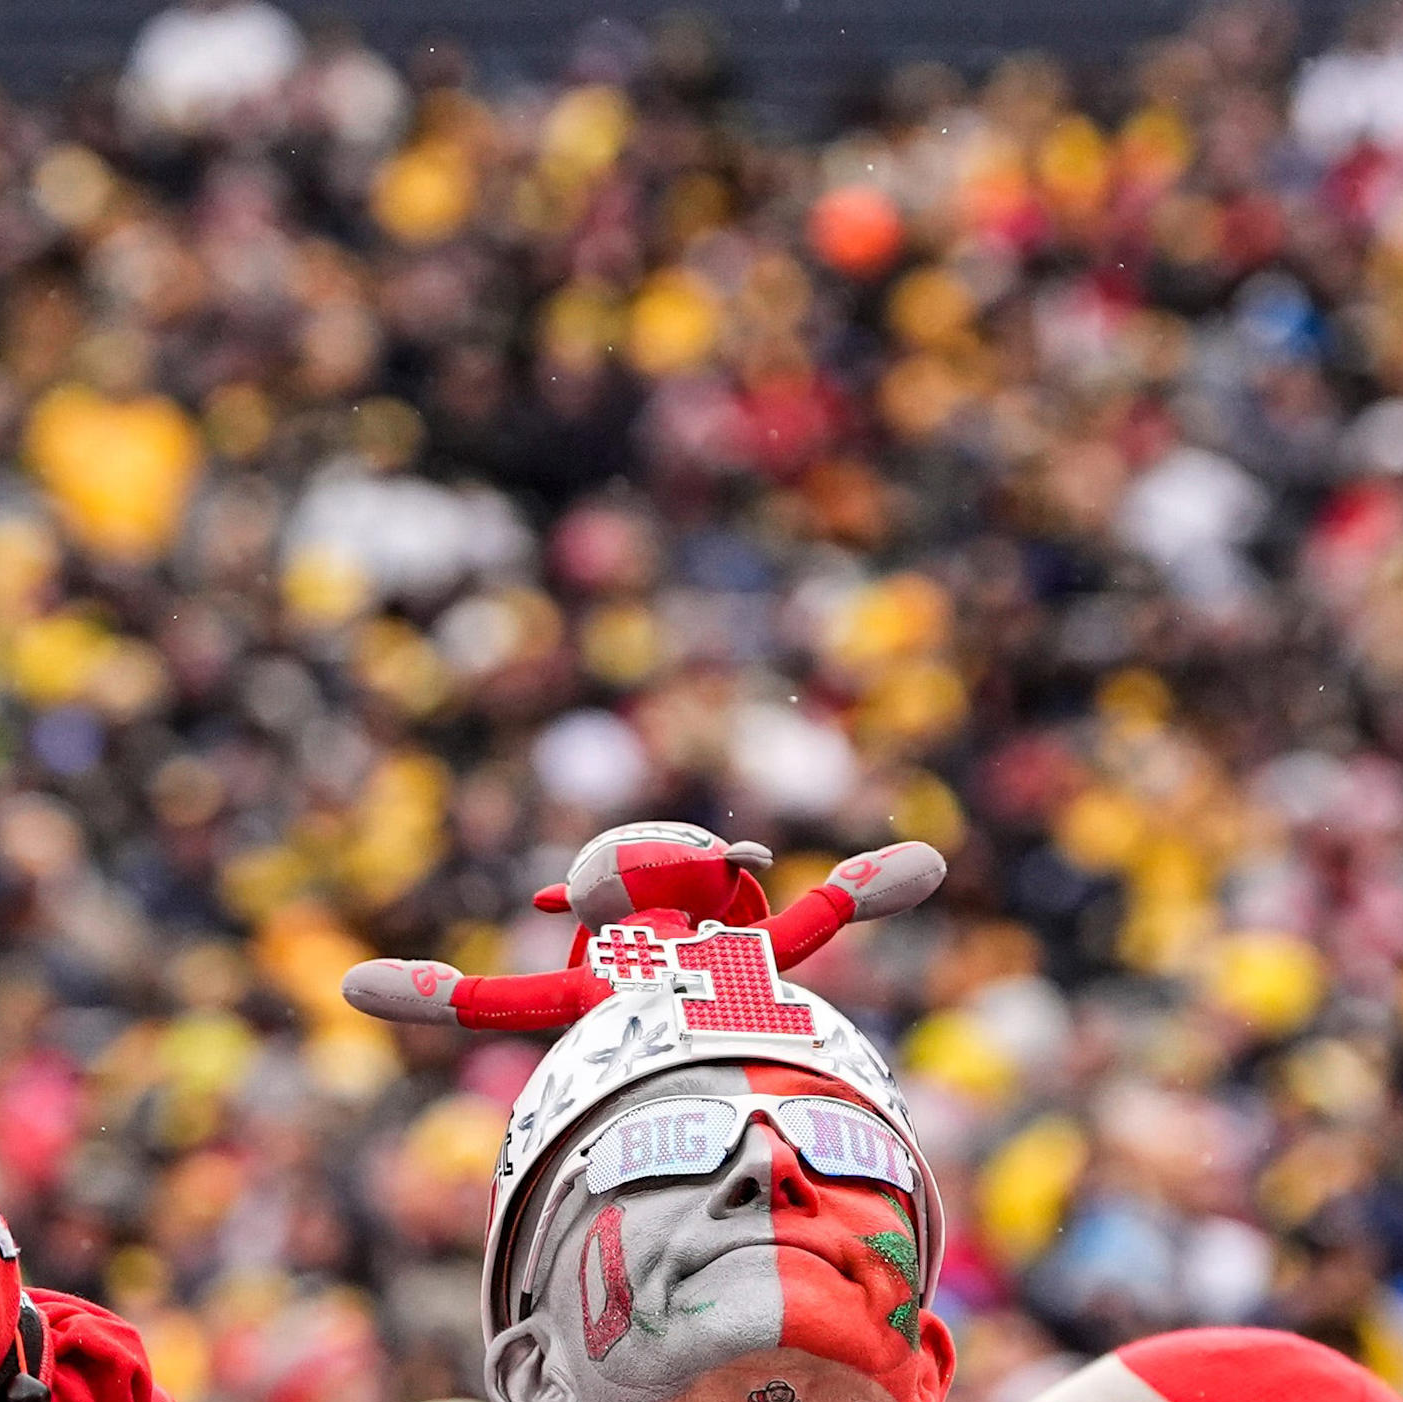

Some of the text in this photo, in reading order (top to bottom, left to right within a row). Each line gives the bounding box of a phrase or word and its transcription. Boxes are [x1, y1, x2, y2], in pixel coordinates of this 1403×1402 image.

[588, 925, 824, 1046] #1
[620, 1108, 898, 1181] BIG NUT
